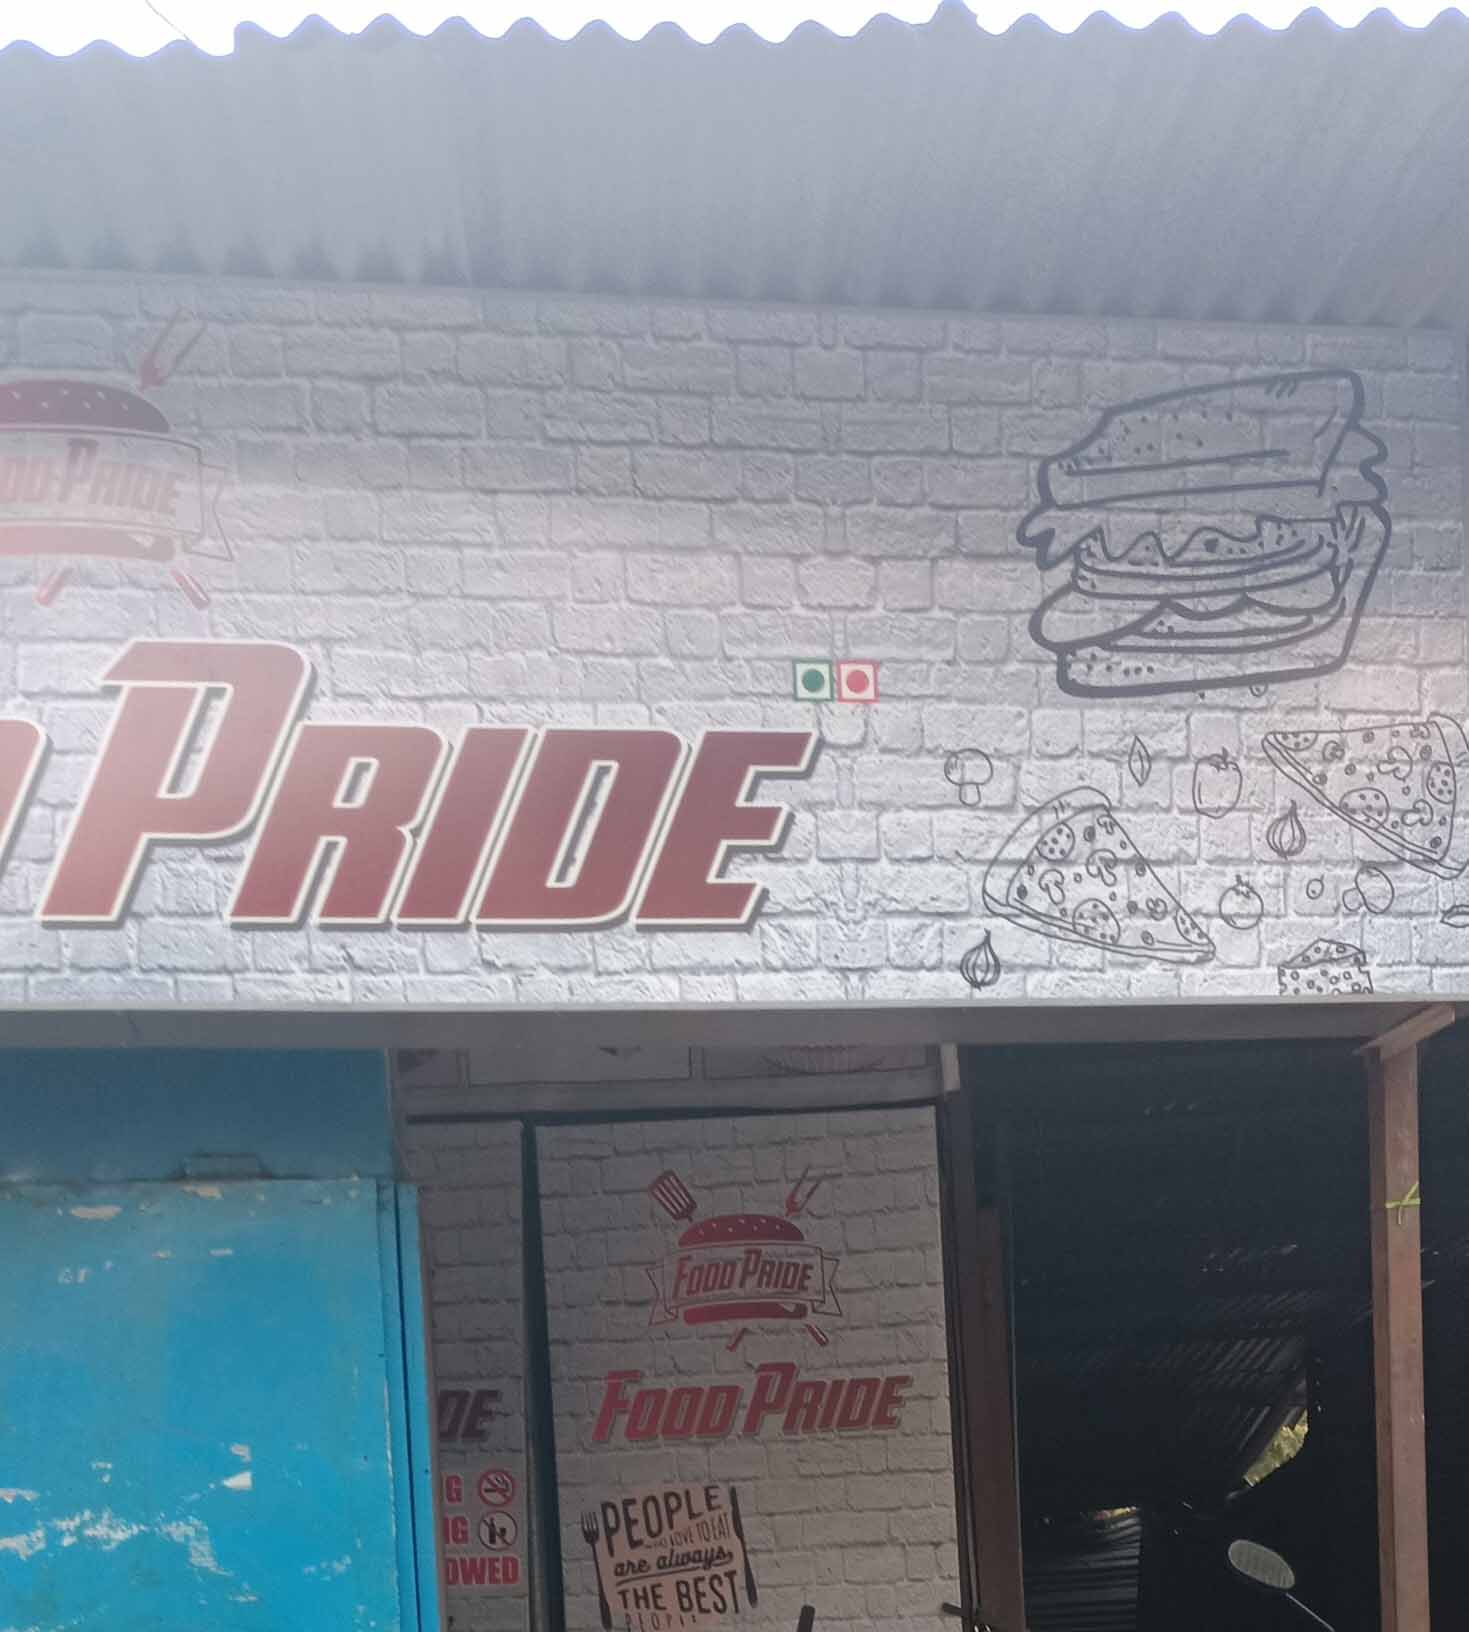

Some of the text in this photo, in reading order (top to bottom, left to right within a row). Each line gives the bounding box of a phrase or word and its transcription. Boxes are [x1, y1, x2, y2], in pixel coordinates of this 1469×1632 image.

[57, 437, 184, 515] PRIDE
[36, 640, 820, 927] PRIDE
[673, 1248, 814, 1298] FOOD PRIDE
[591, 1362, 913, 1441] FOOD PRIDE
[601, 1484, 722, 1558] PEOPLE
[613, 1545, 735, 1577] are always
[617, 1570, 741, 1615] THE BEST
